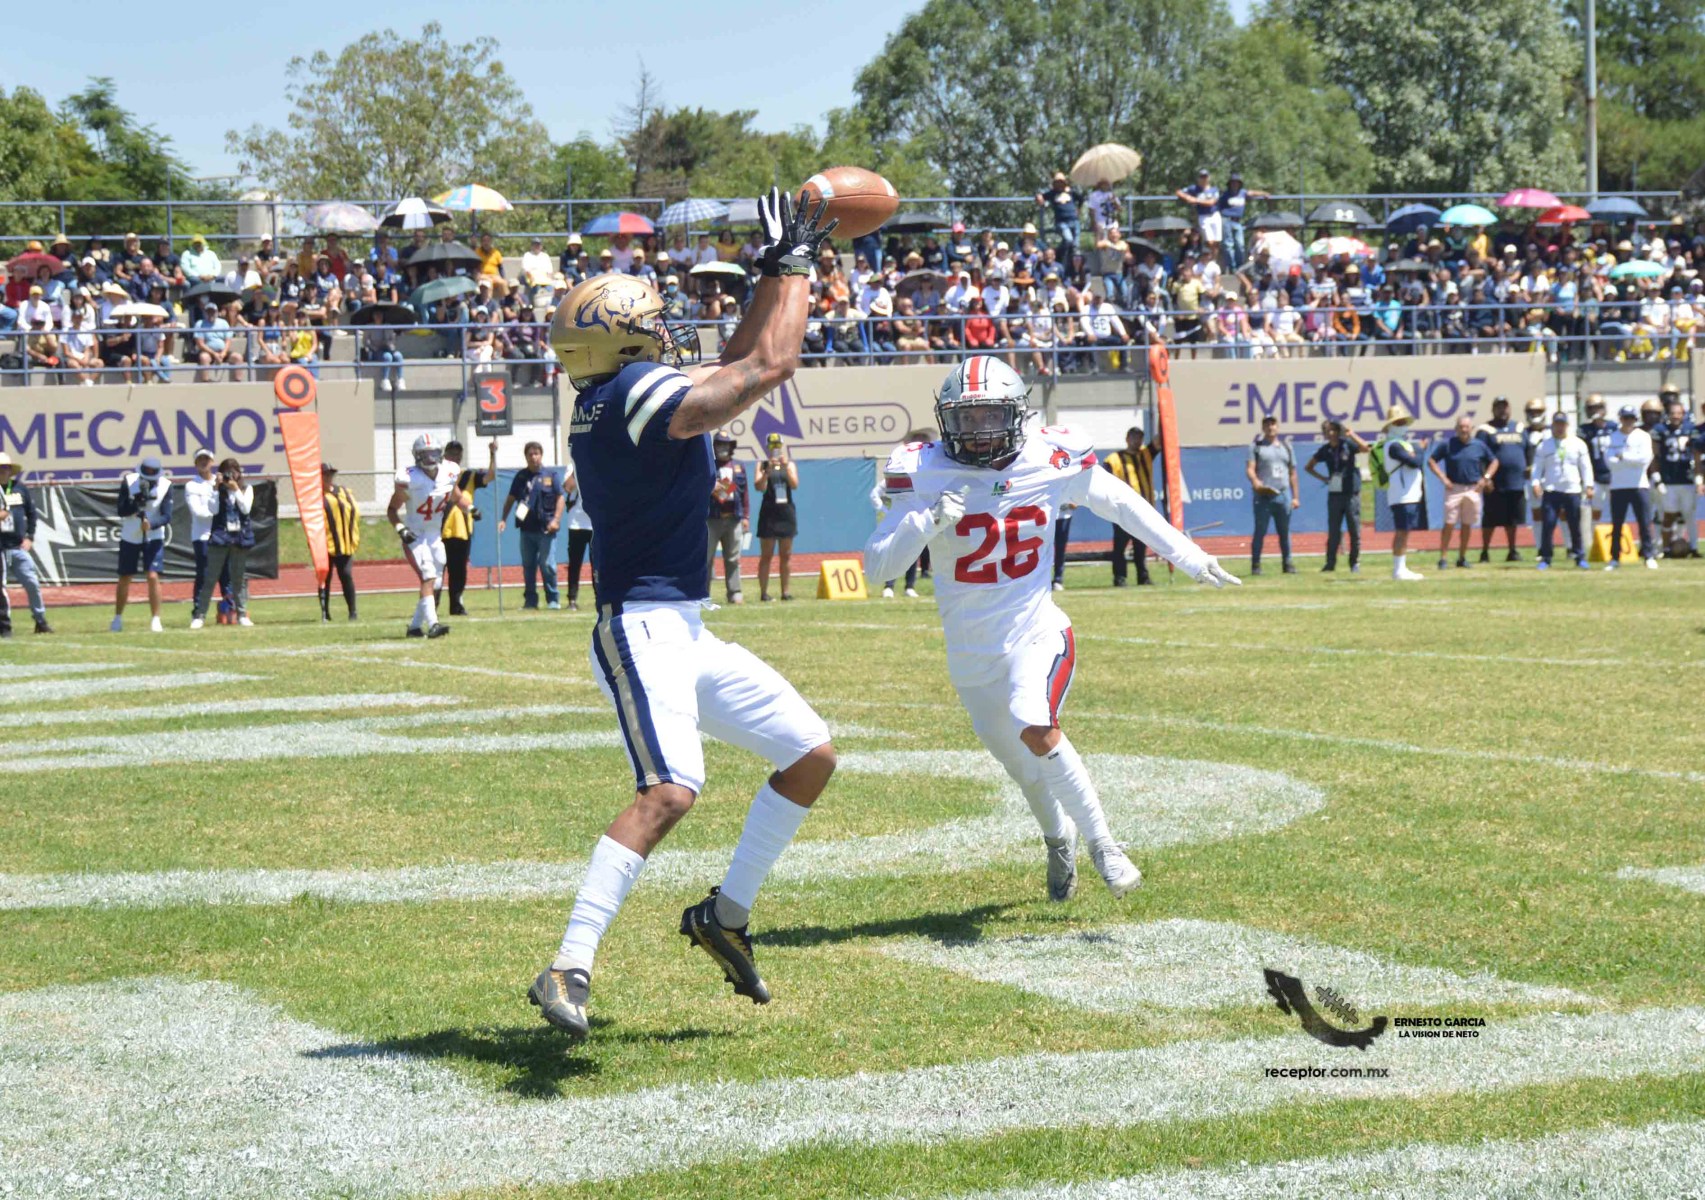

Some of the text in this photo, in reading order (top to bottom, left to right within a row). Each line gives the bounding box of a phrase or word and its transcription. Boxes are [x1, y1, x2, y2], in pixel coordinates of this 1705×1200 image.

[480, 378, 506, 413] 3
[1247, 377, 1460, 425] MECANO
[0, 407, 266, 459] MECANO
[809, 414, 896, 435] NEGRO
[1192, 487, 1244, 501] NEGRO
[78, 526, 121, 542] NEG
[954, 504, 1047, 584] 26
[831, 568, 858, 593] 10
